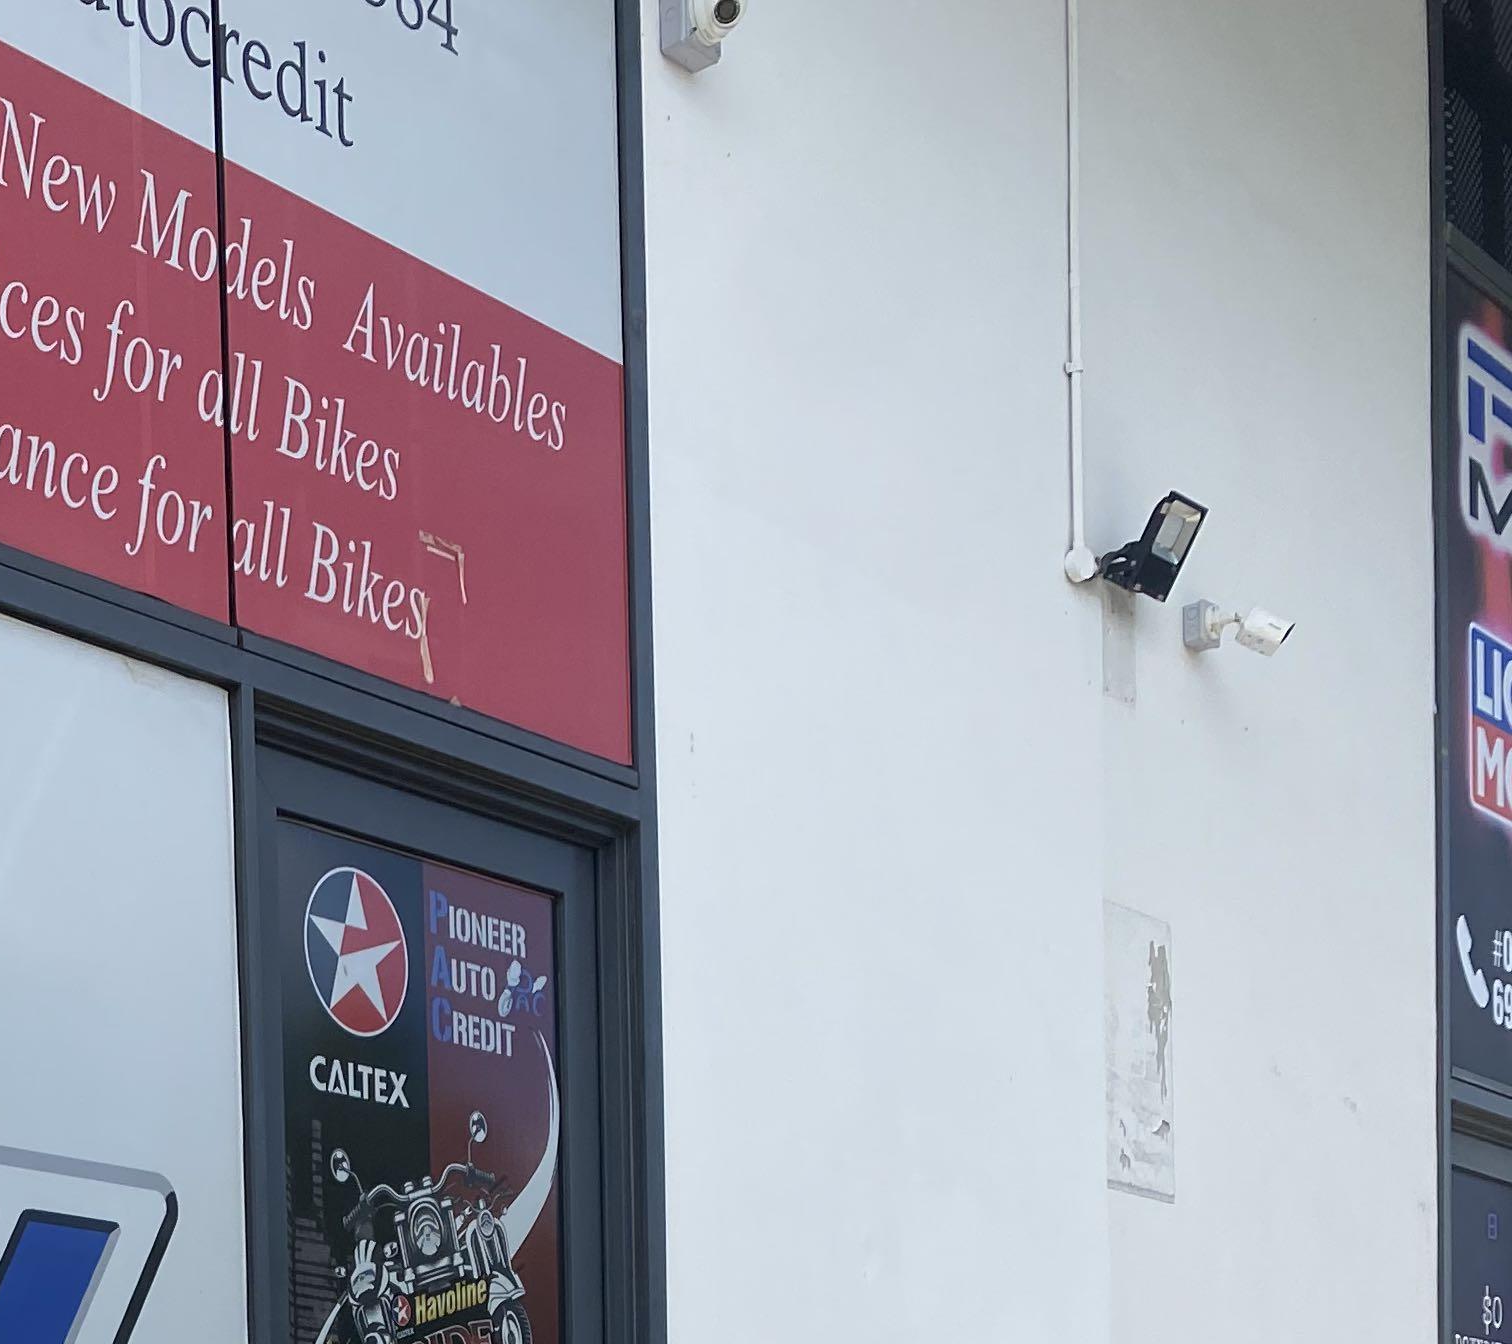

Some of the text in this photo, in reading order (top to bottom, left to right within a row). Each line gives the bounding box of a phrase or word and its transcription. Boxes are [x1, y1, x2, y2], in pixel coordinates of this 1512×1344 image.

[131, 168, 316, 331] Models
[342, 282, 566, 451] Availables
[92, 300, 183, 402] for
[197, 352, 262, 442] all
[275, 375, 400, 501] Bikes
[124, 454, 213, 556] for
[232, 500, 291, 589] all
[304, 522, 428, 641] Bikes
[429, 889, 527, 958] PIONEER
[431, 945, 497, 1001] AUTO
[431, 996, 516, 1057] CREDIT
[309, 1054, 410, 1108] CALTEX
[414, 1280, 488, 1326] Havoline
[1482, 1285, 1503, 1336] $0
